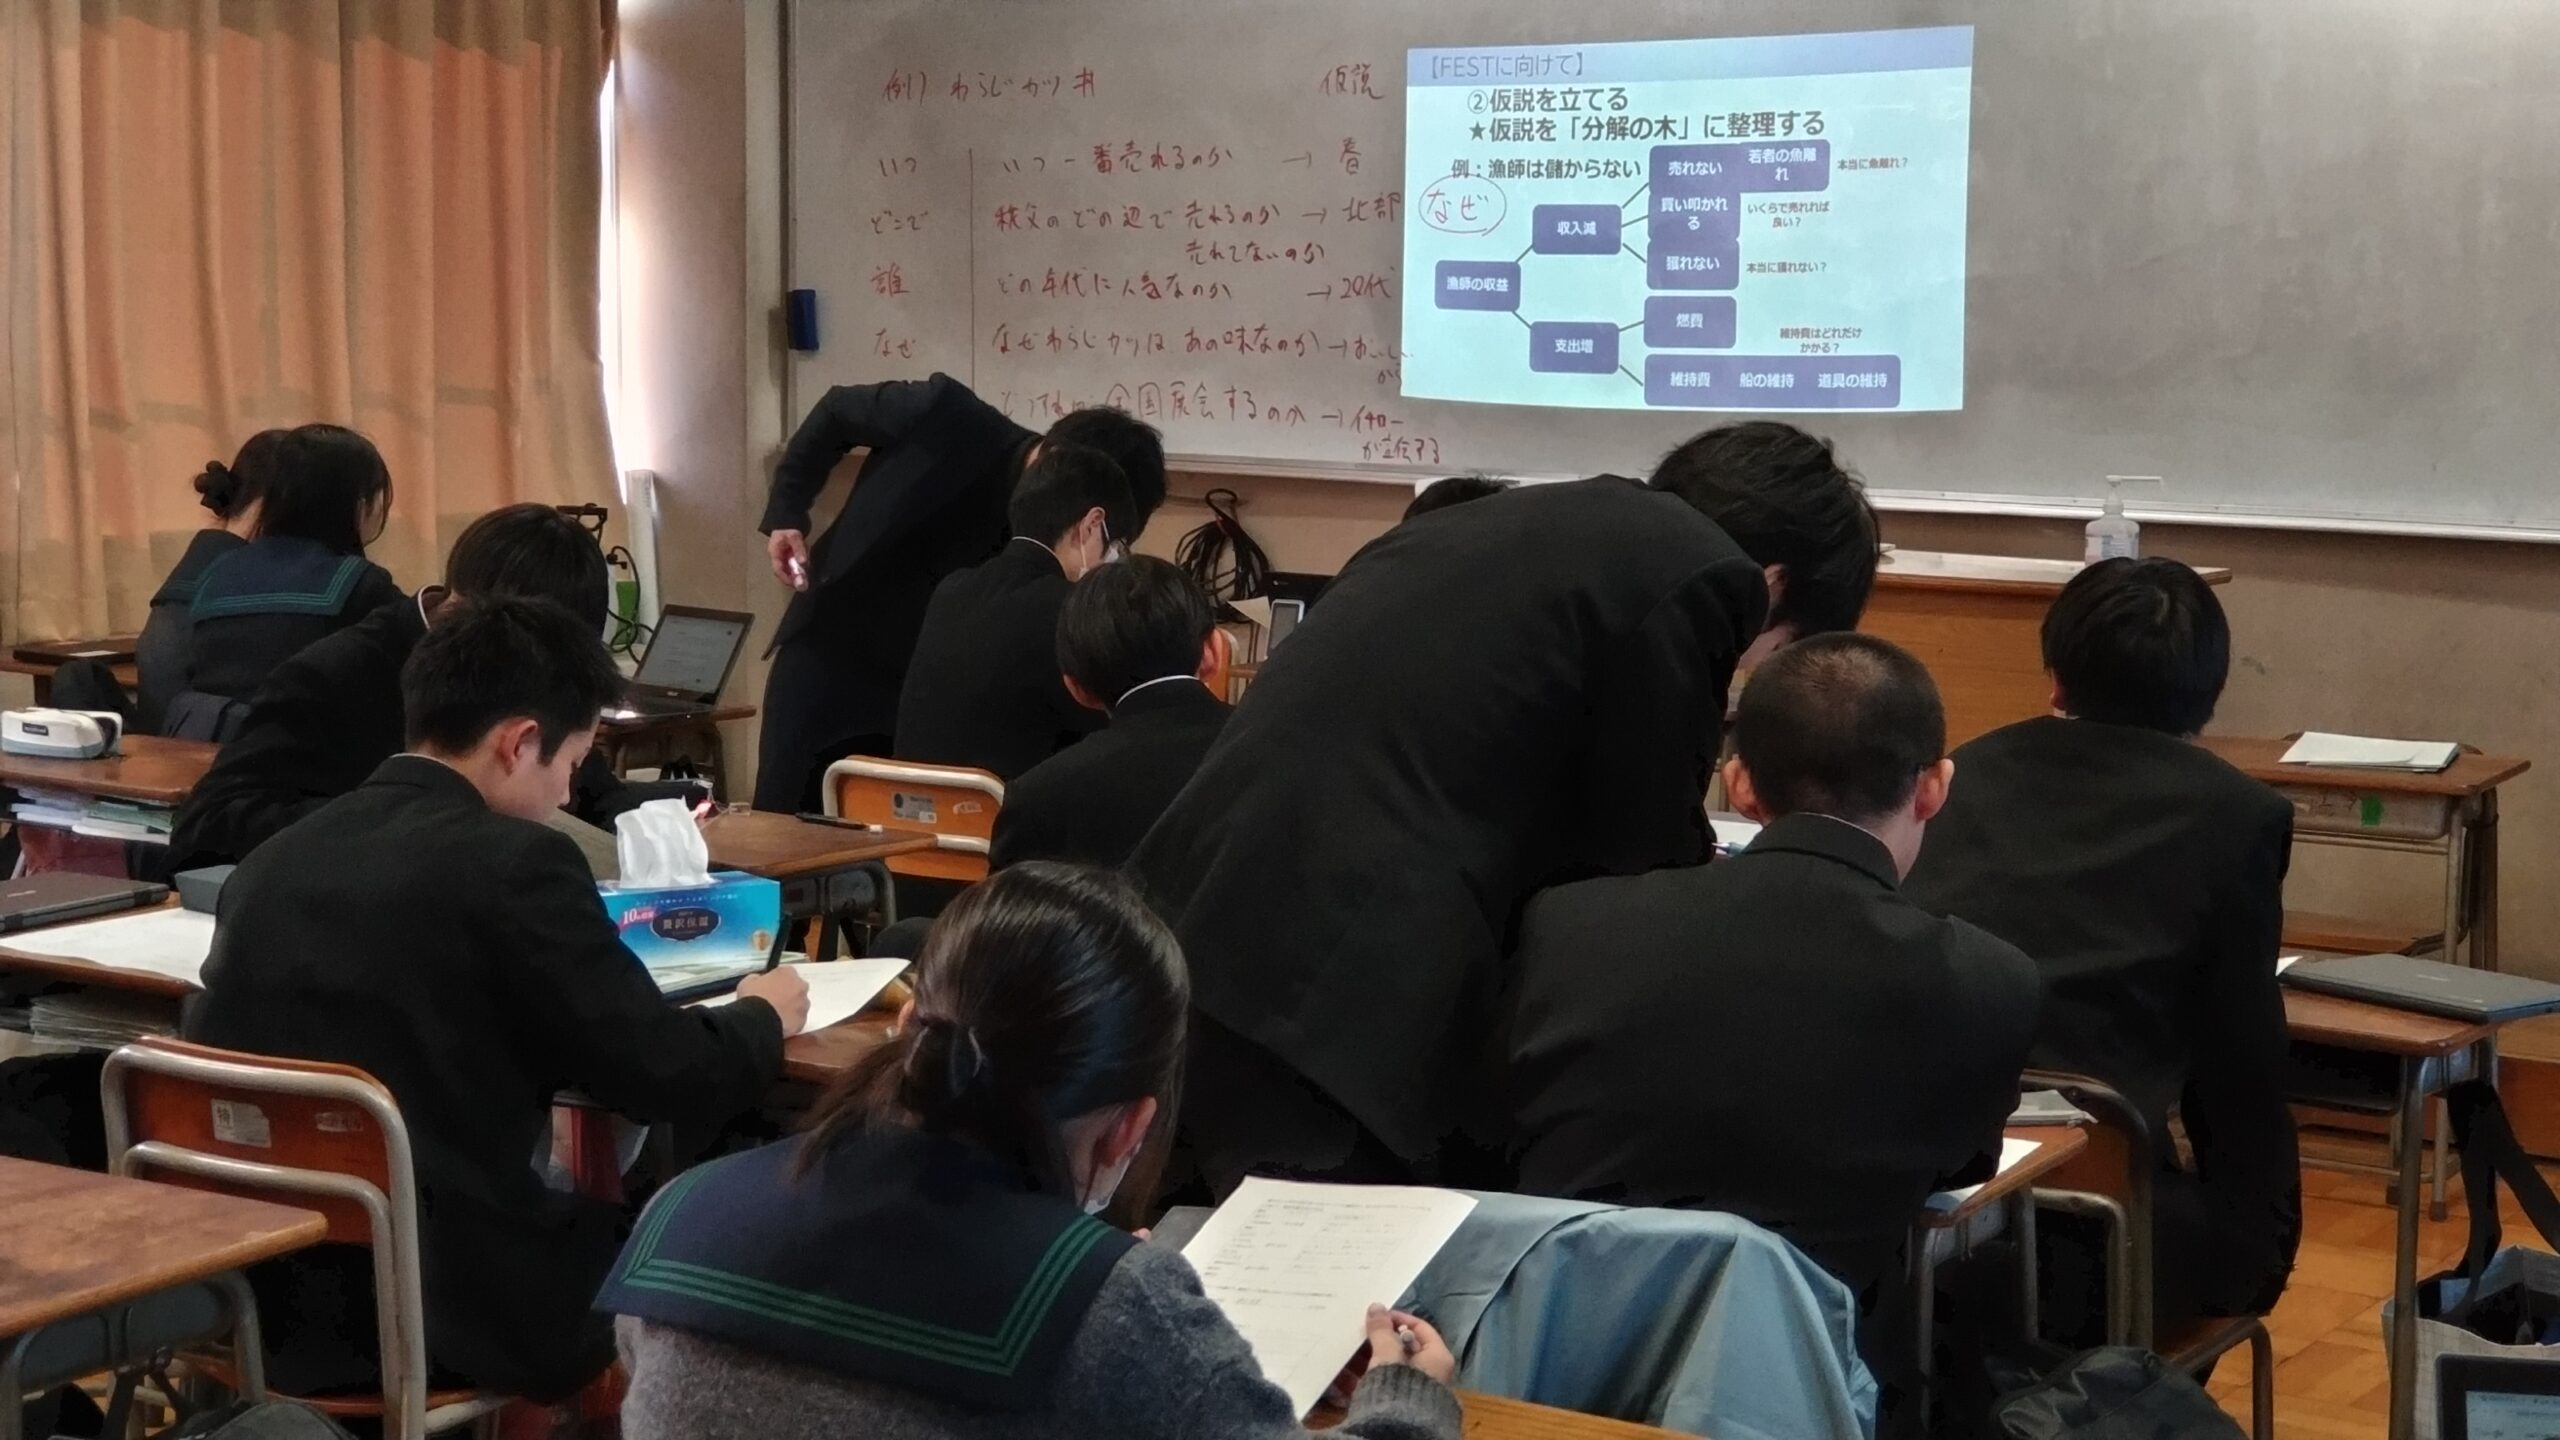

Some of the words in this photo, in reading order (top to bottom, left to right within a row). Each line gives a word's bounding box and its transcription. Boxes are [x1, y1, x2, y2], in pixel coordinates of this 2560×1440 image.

[1431, 52, 1583, 79] 【FESTに向けて】
[1320, 63, 1384, 99] 仮説
[1339, 137, 1362, 174] 春
[879, 157, 917, 177] いつ
[1668, 160, 1723, 177] 売れない
[1774, 167, 1790, 182] れ
[1342, 192, 1401, 223] 北部
[1427, 188, 1489, 224] なぜ
[1660, 196, 1728, 212] 買い叩かれ
[1747, 201, 1830, 214] いくらで売れれば
[871, 210, 929, 234] どこで
[1557, 221, 1597, 236] 収入減
[1687, 216, 1701, 231] る
[1186, 241, 1325, 265] 売れてないのか
[870, 262, 911, 297] 誰
[1446, 276, 1509, 292] 漁師の収益
[1676, 313, 1704, 329] 燃費
[1780, 327, 1862, 340] 維持費はどれだけ
[874, 328, 917, 359] なぜ
[1554, 339, 1594, 354] 支出増
[1670, 371, 1711, 388] 維持費
[1739, 372, 1795, 388] 船の維持
[1817, 372, 1888, 389] 道具の維持
